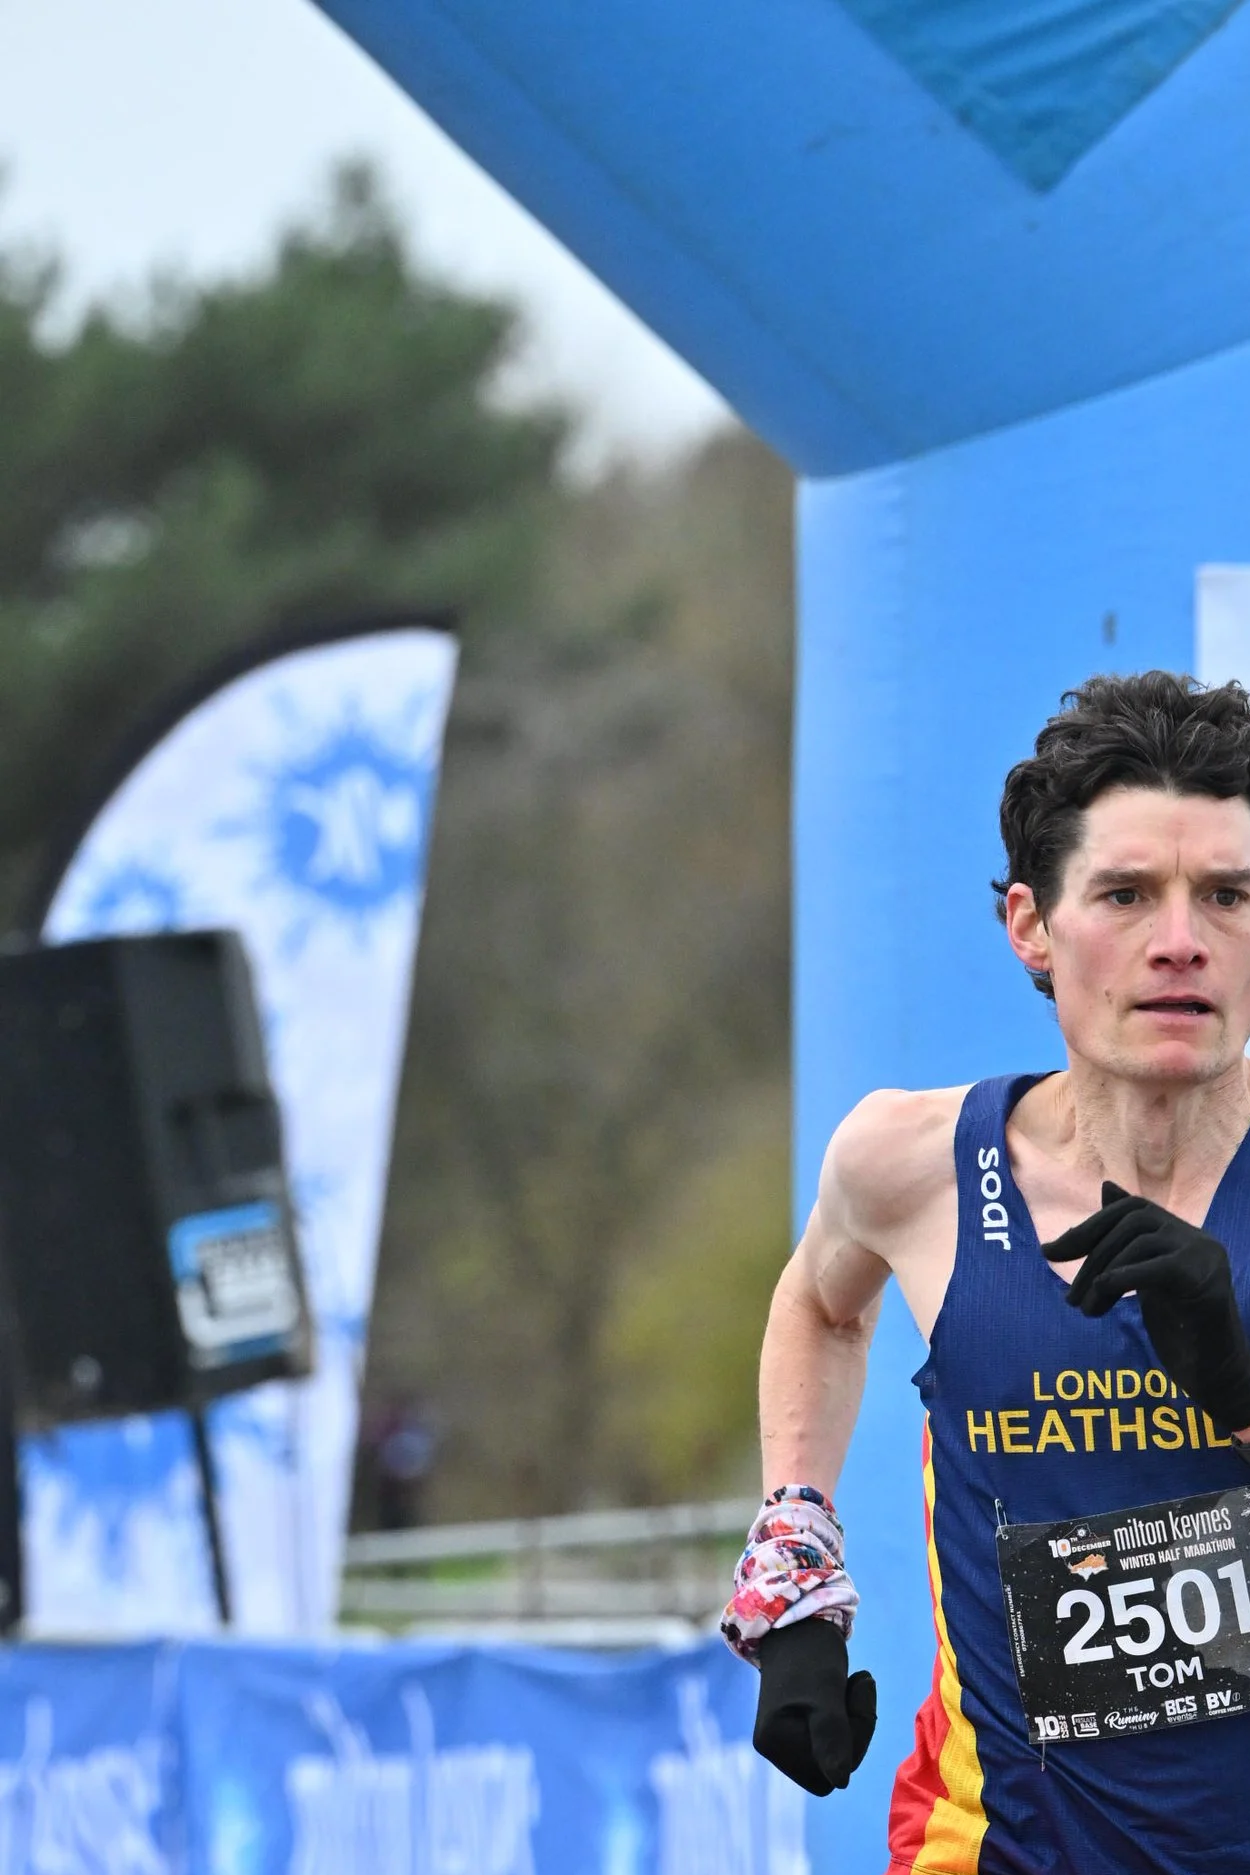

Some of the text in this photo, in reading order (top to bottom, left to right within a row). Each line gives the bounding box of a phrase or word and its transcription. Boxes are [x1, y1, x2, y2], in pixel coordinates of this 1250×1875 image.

[977, 1146, 1012, 1251] soar
[1113, 1507, 1232, 1552] milton keynes
[1071, 1539, 1112, 1554] DECEMBER
[1119, 1538, 1236, 1571] WINTER HALF MARATHON
[1126, 1656, 1205, 1693] TOM
[1123, 1706, 1139, 1714] THE
[1164, 1695, 1198, 1716] BCS
[1205, 1689, 1232, 1710] BV
[1080, 1722, 1098, 1730] BASE
[1104, 1710, 1160, 1730] Running
[1131, 1722, 1149, 1731] HUB
